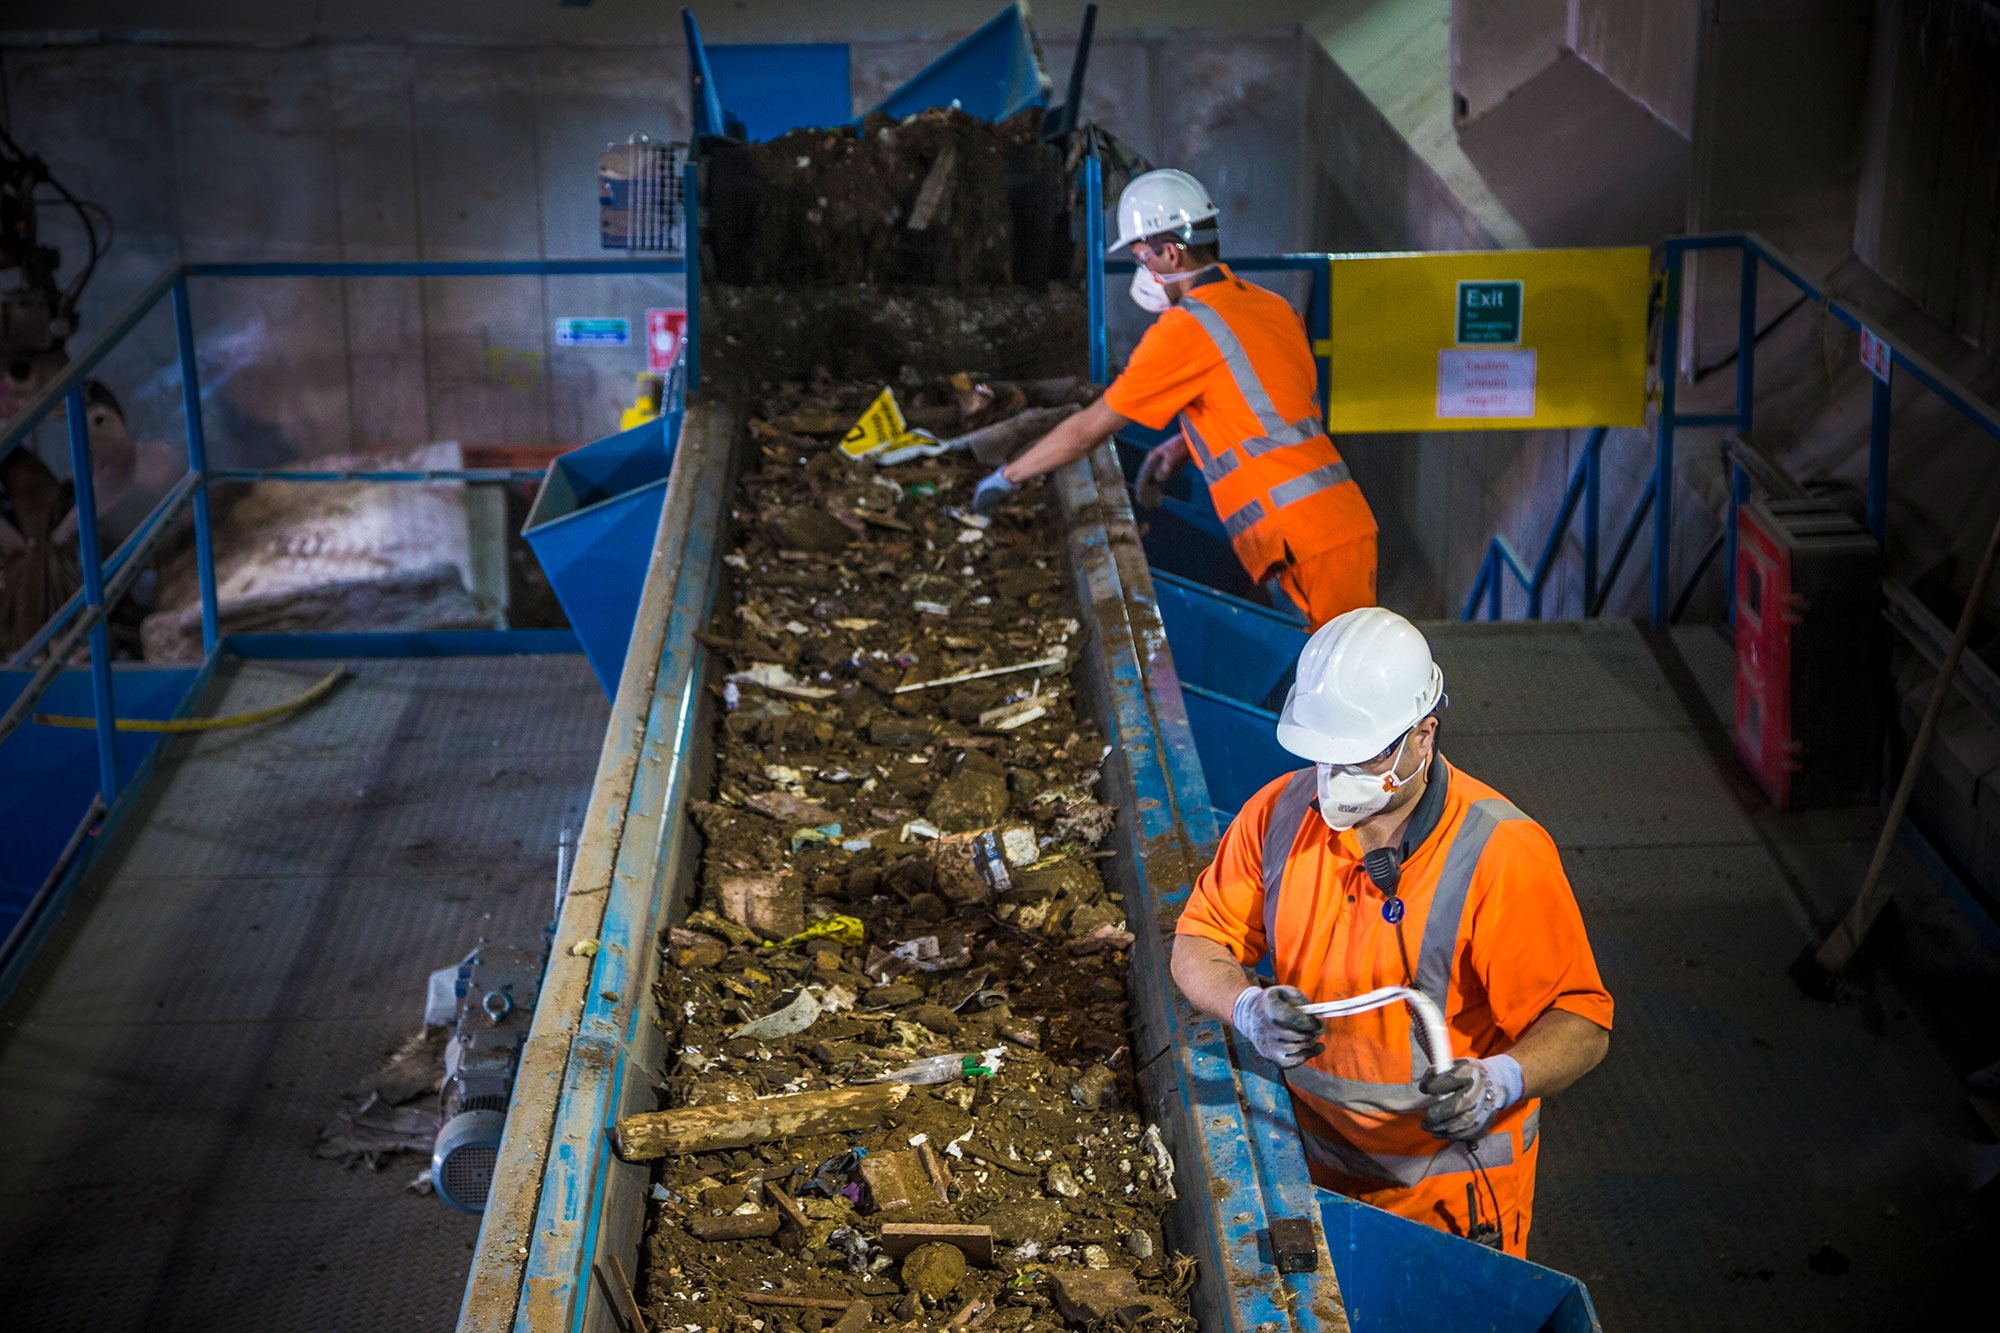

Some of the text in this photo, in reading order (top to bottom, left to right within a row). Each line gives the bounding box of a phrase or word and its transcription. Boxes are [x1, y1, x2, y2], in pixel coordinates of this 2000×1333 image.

[1467, 289, 1504, 307] Exit
[1467, 322, 1511, 331] emergency
[1467, 361, 1508, 371] Caution
[1467, 380, 1507, 388] uneven
